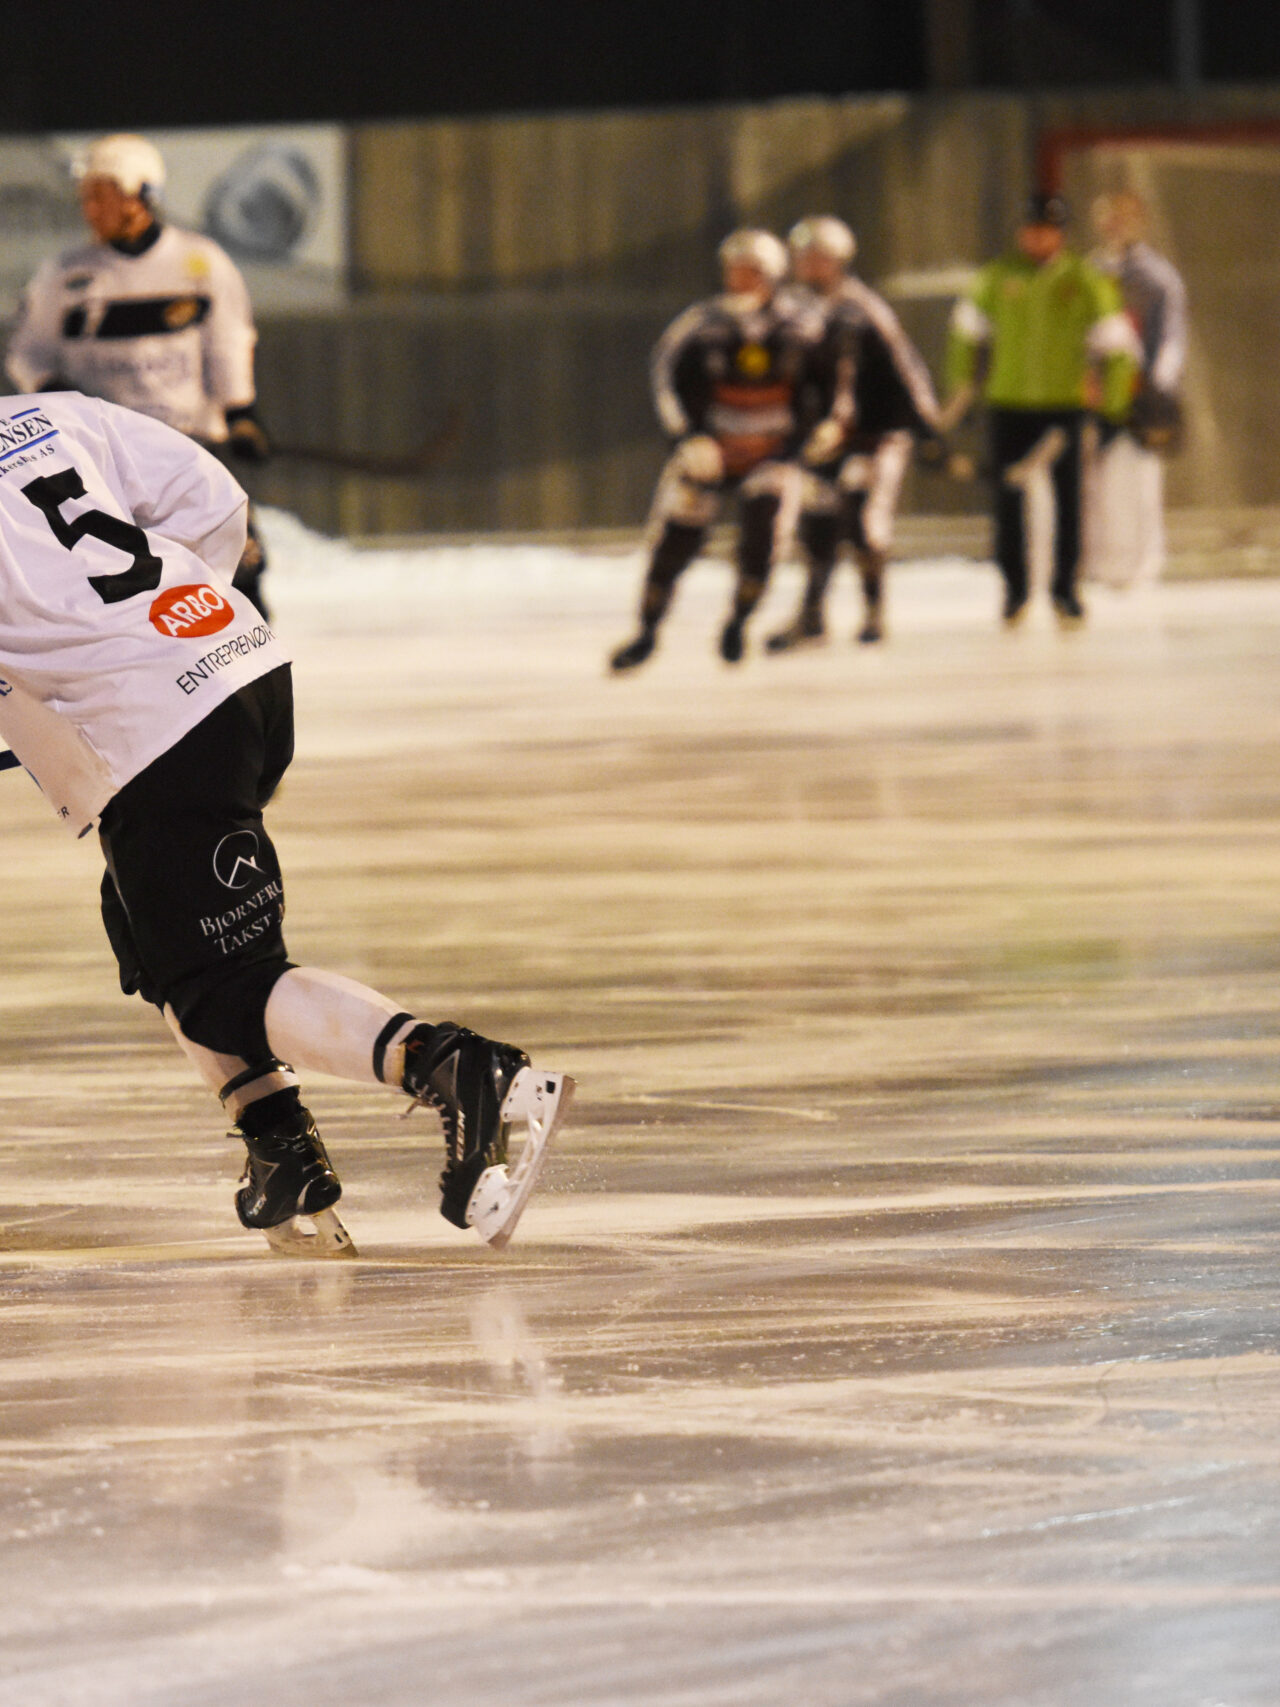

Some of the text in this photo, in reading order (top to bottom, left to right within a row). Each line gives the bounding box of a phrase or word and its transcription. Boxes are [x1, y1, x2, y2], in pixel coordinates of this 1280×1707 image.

[39, 443, 56, 458] AS
[20, 466, 163, 605] 5
[158, 587, 225, 637] ARBO
[213, 913, 271, 955] TAKST
